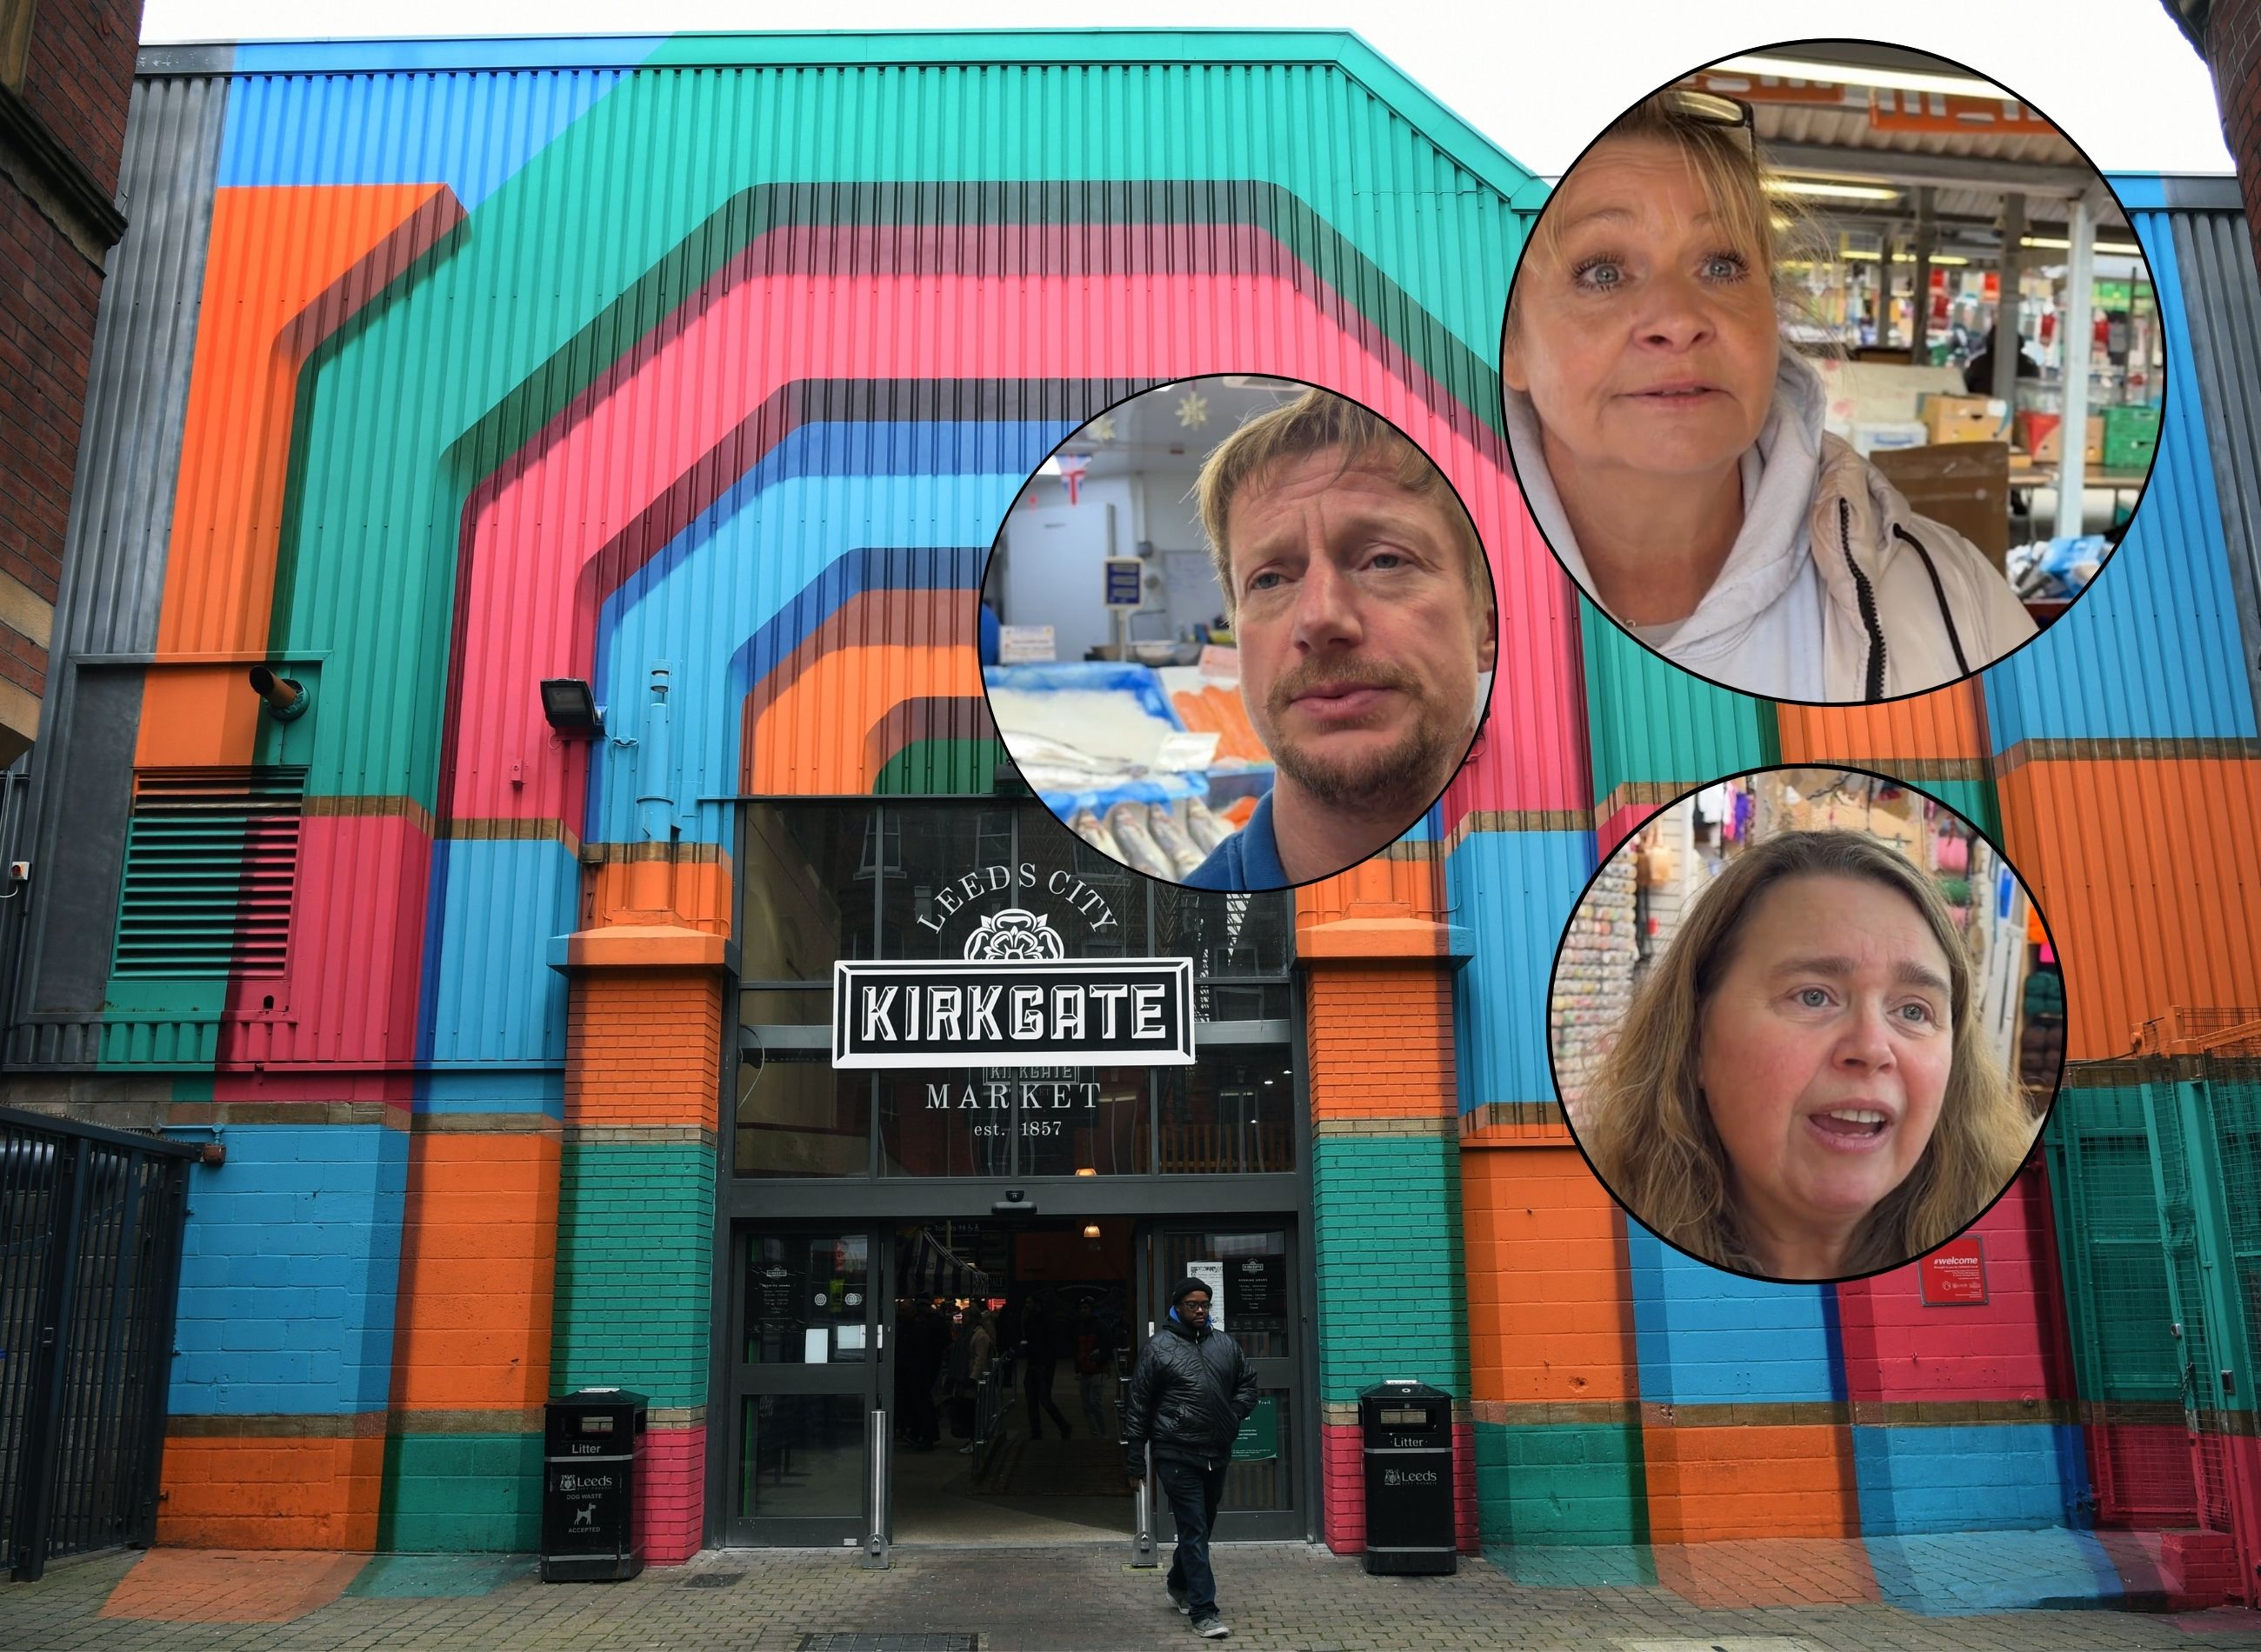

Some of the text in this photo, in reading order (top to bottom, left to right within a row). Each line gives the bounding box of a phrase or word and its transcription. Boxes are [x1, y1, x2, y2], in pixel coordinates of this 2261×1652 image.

[917, 863, 1118, 934] LEEDS CITY
[861, 984, 1167, 1042] KIRKGATE
[925, 1083, 1101, 1109] MARKET
[974, 1121, 1062, 1136] est. 1857
[1934, 1256, 1978, 1265] #welcome
[1394, 1437, 1424, 1447] Litter
[572, 1443, 601, 1454] Litter
[577, 1475, 612, 1487] Leeds
[1402, 1470, 1437, 1482] Leeds
